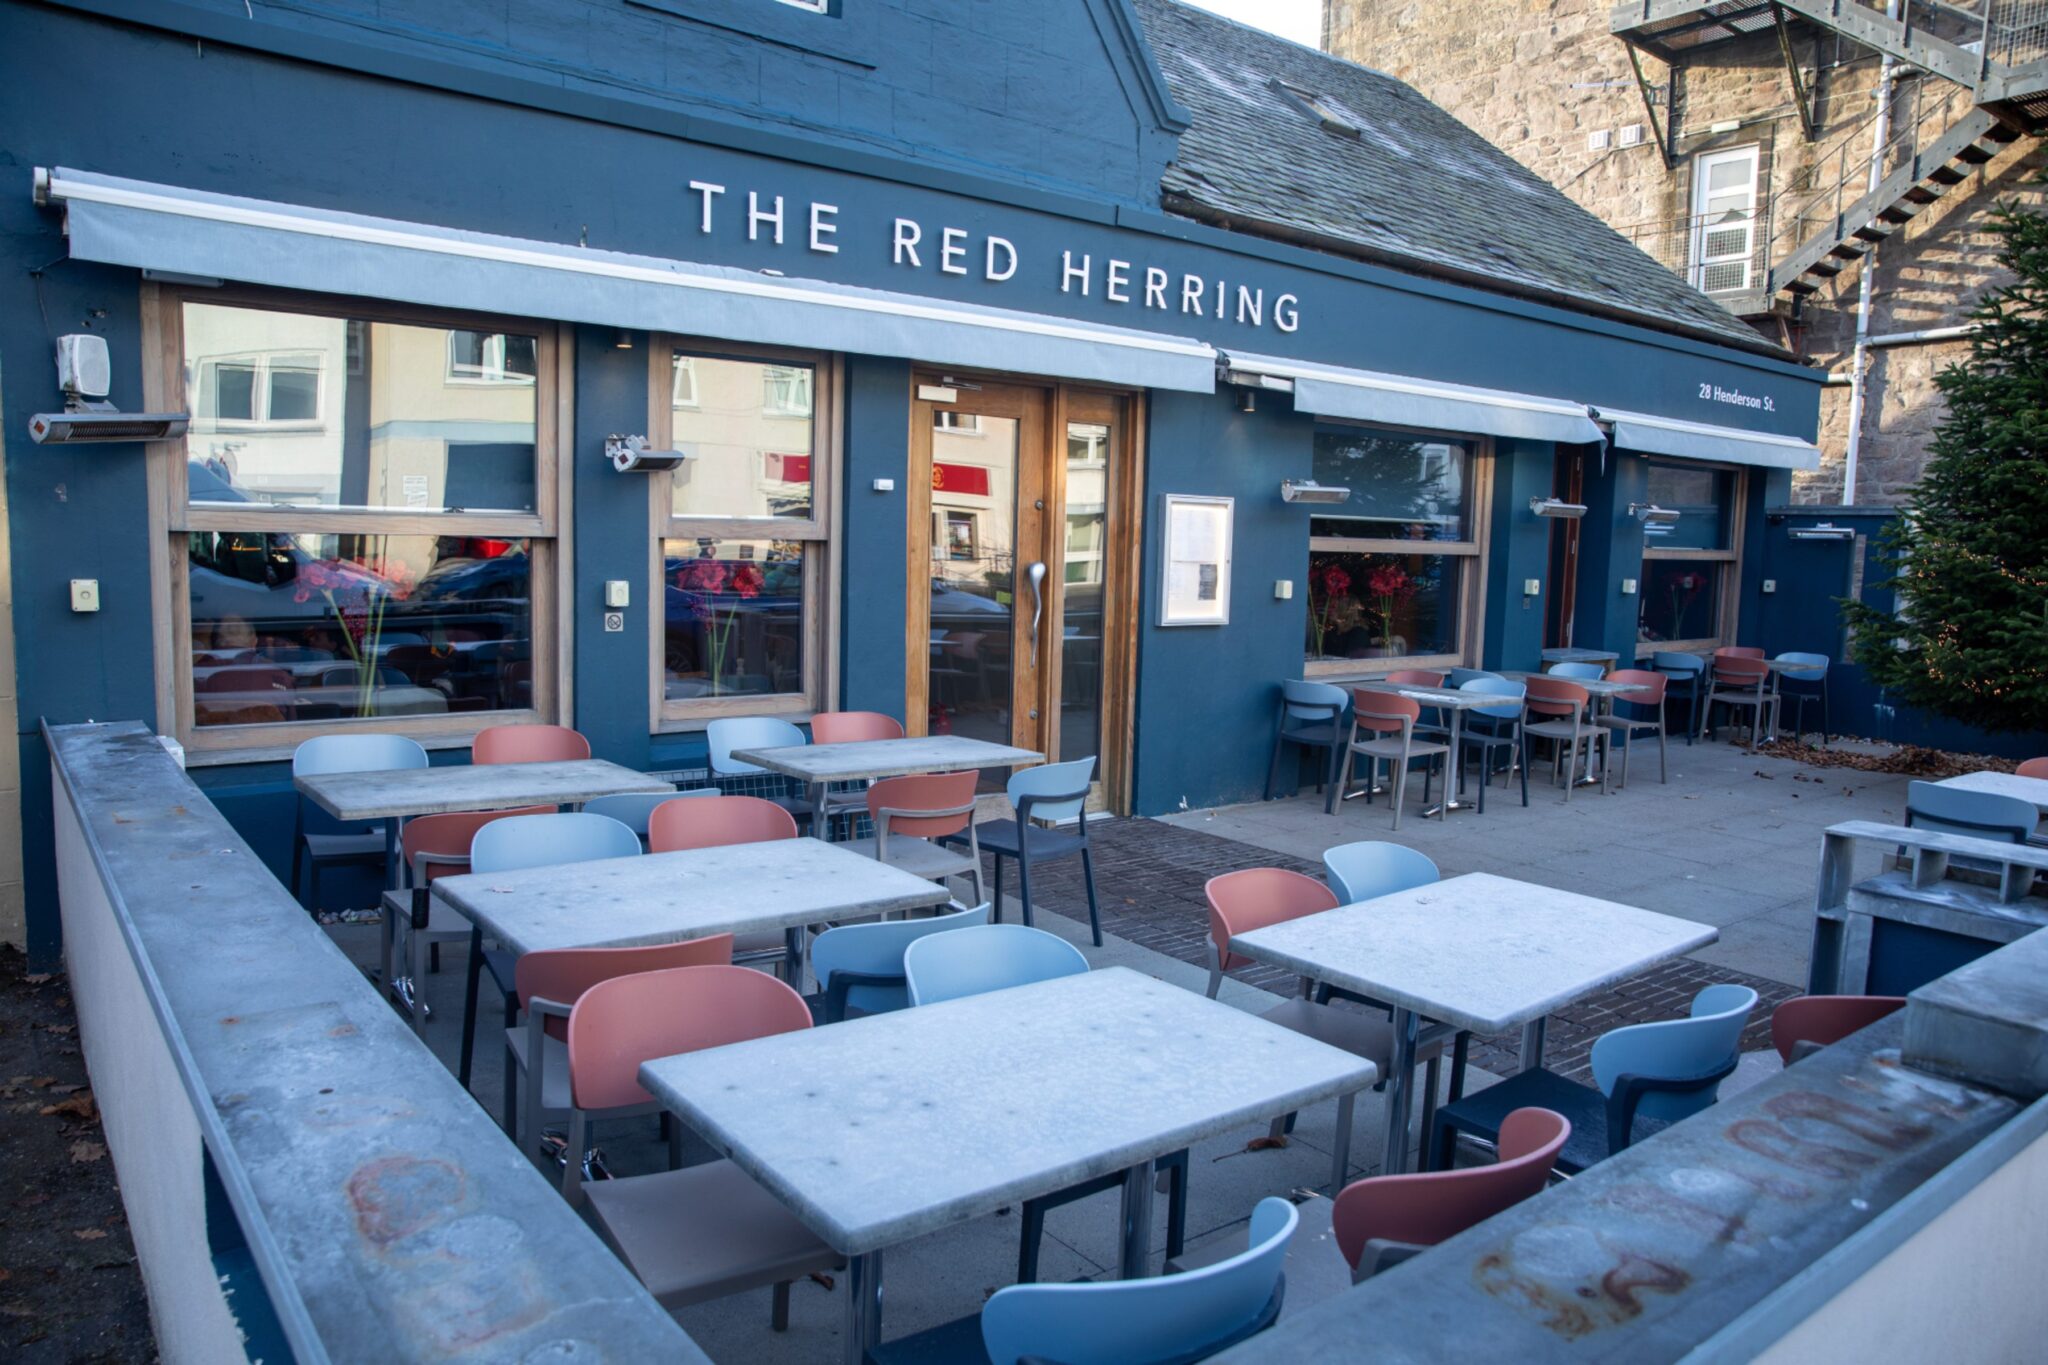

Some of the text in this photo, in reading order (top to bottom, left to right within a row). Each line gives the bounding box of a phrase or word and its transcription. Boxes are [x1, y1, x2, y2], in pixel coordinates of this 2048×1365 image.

[689, 179, 1300, 333] THE RED HERRING
[1698, 383, 1776, 412] 28 Henderson St.
